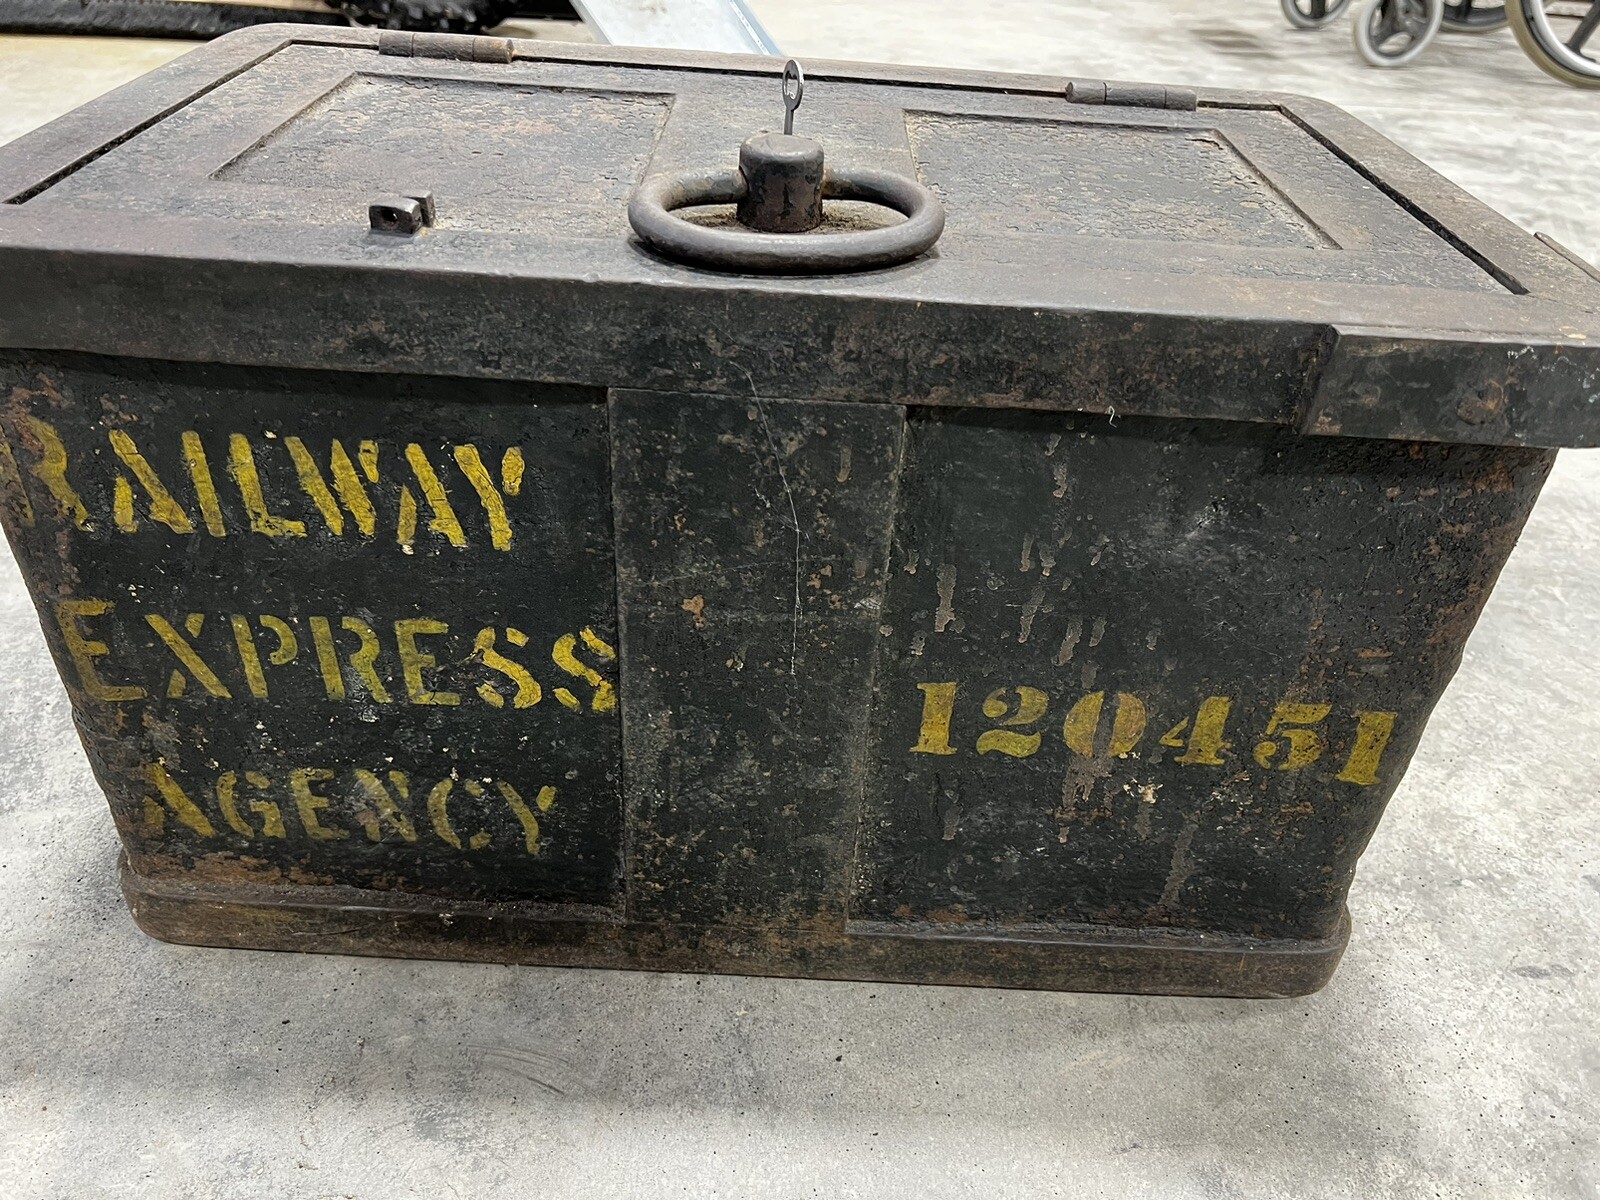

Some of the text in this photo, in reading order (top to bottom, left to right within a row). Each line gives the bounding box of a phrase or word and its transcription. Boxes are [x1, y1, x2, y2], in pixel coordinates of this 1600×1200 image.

[0, 415, 525, 553] RAILWAY
[56, 599, 616, 712] EXPRESS
[909, 681, 1398, 786] 120451
[142, 763, 556, 855] AGENCY
